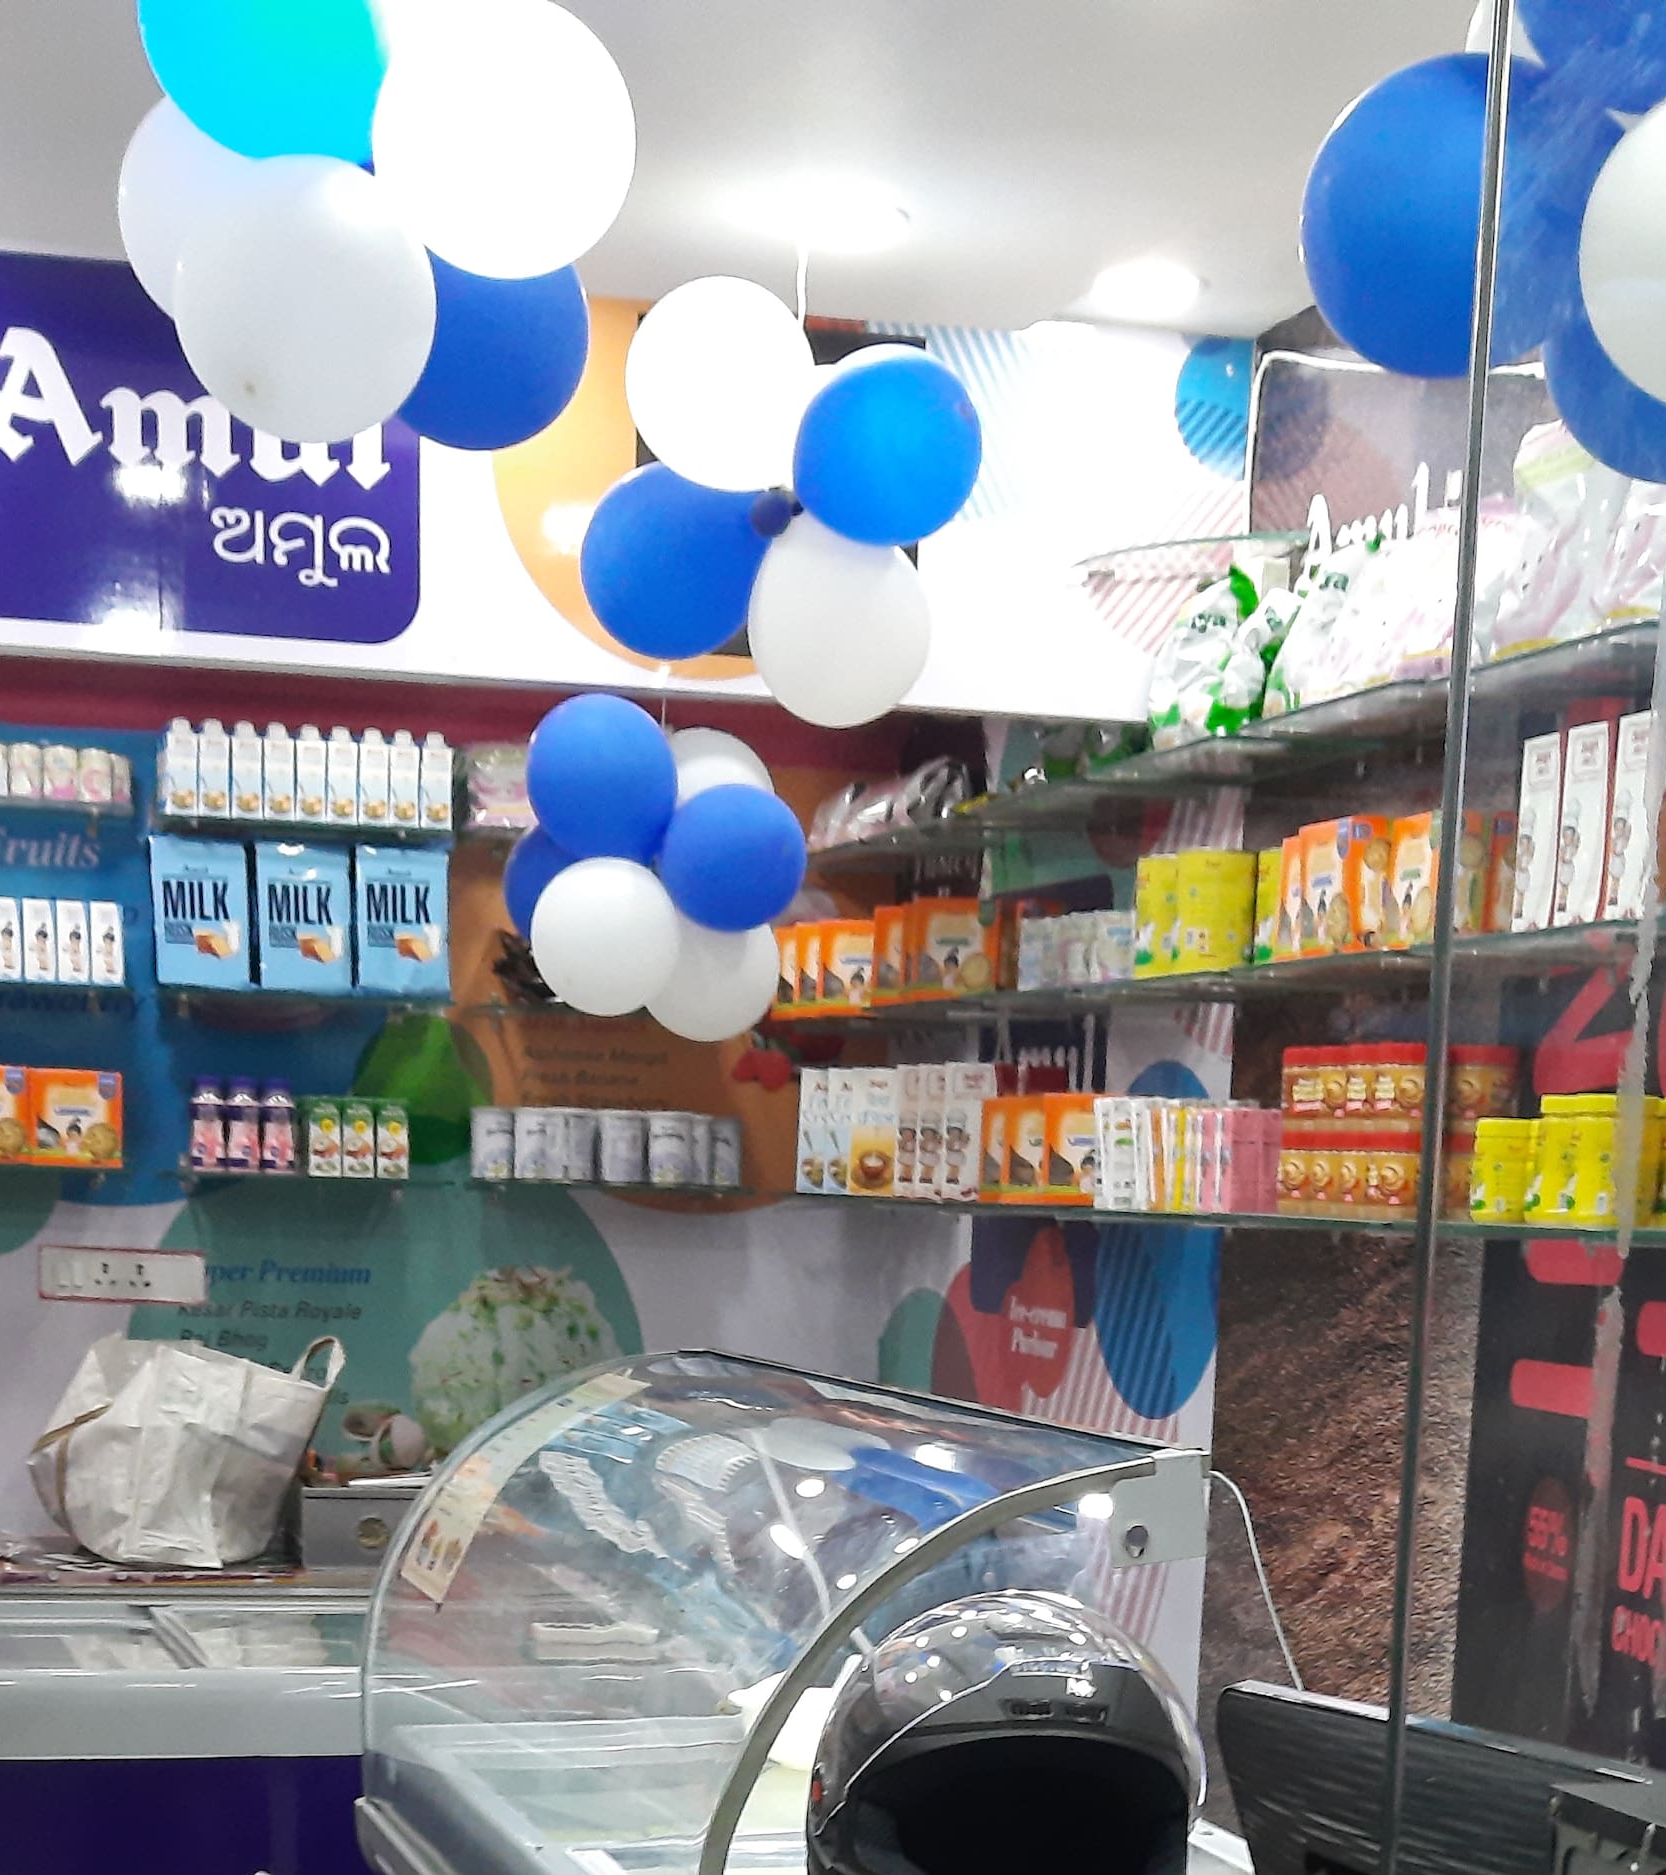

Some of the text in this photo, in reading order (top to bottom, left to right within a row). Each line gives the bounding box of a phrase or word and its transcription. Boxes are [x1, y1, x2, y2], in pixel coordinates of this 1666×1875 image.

[162, 879, 231, 922] MILK
[267, 883, 333, 925] MILK
[365, 882, 431, 925] MILK
[259, 1258, 372, 1285] Premium
